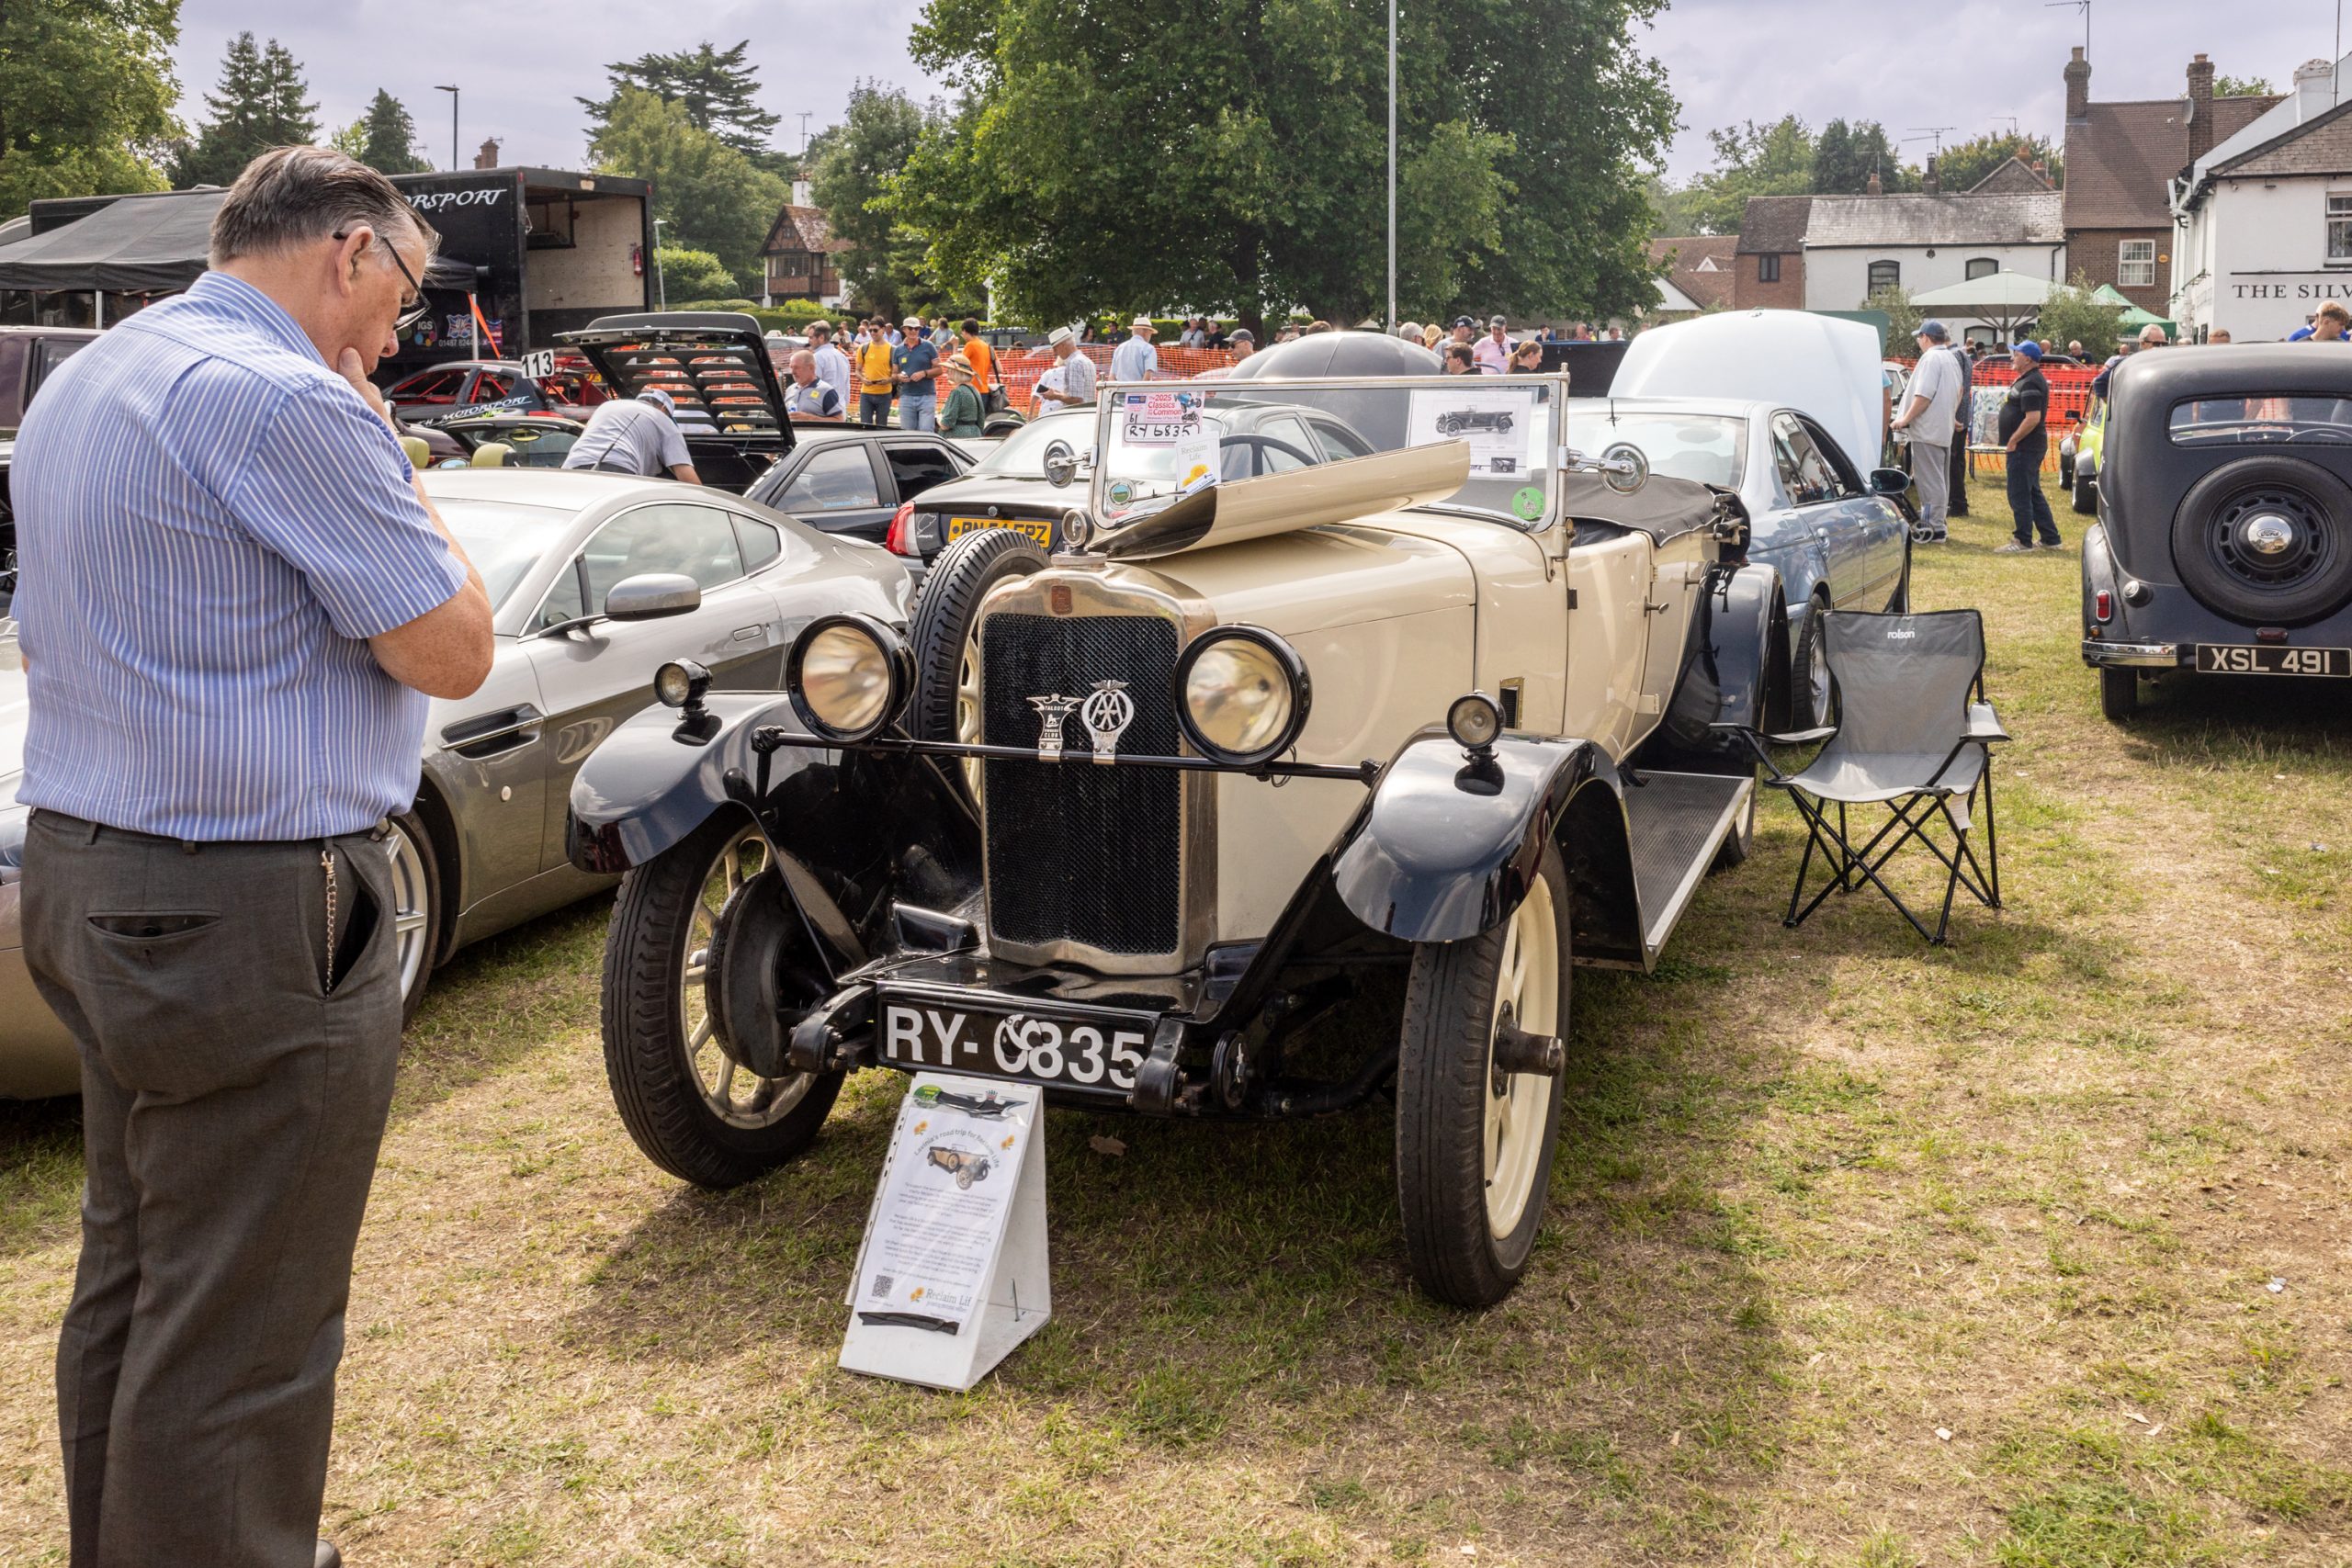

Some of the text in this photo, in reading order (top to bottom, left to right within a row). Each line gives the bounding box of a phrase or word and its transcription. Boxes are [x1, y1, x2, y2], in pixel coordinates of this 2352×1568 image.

[2232, 284, 2352, 299] THE SILV
[417, 321, 433, 330] IGS
[522, 352, 553, 378] 113
[441, 395, 530, 422] MOTORSPORT
[1148, 400, 1175, 409] Classics
[1129, 423, 1193, 437] RY 6835
[1182, 443, 1208, 455] Reclaim
[2211, 648, 2331, 674] XSL 491
[939, 1129, 955, 1138] road
[955, 1128, 967, 1137] trip
[967, 1130, 978, 1139] for
[926, 1289, 957, 1304] Reclaim
